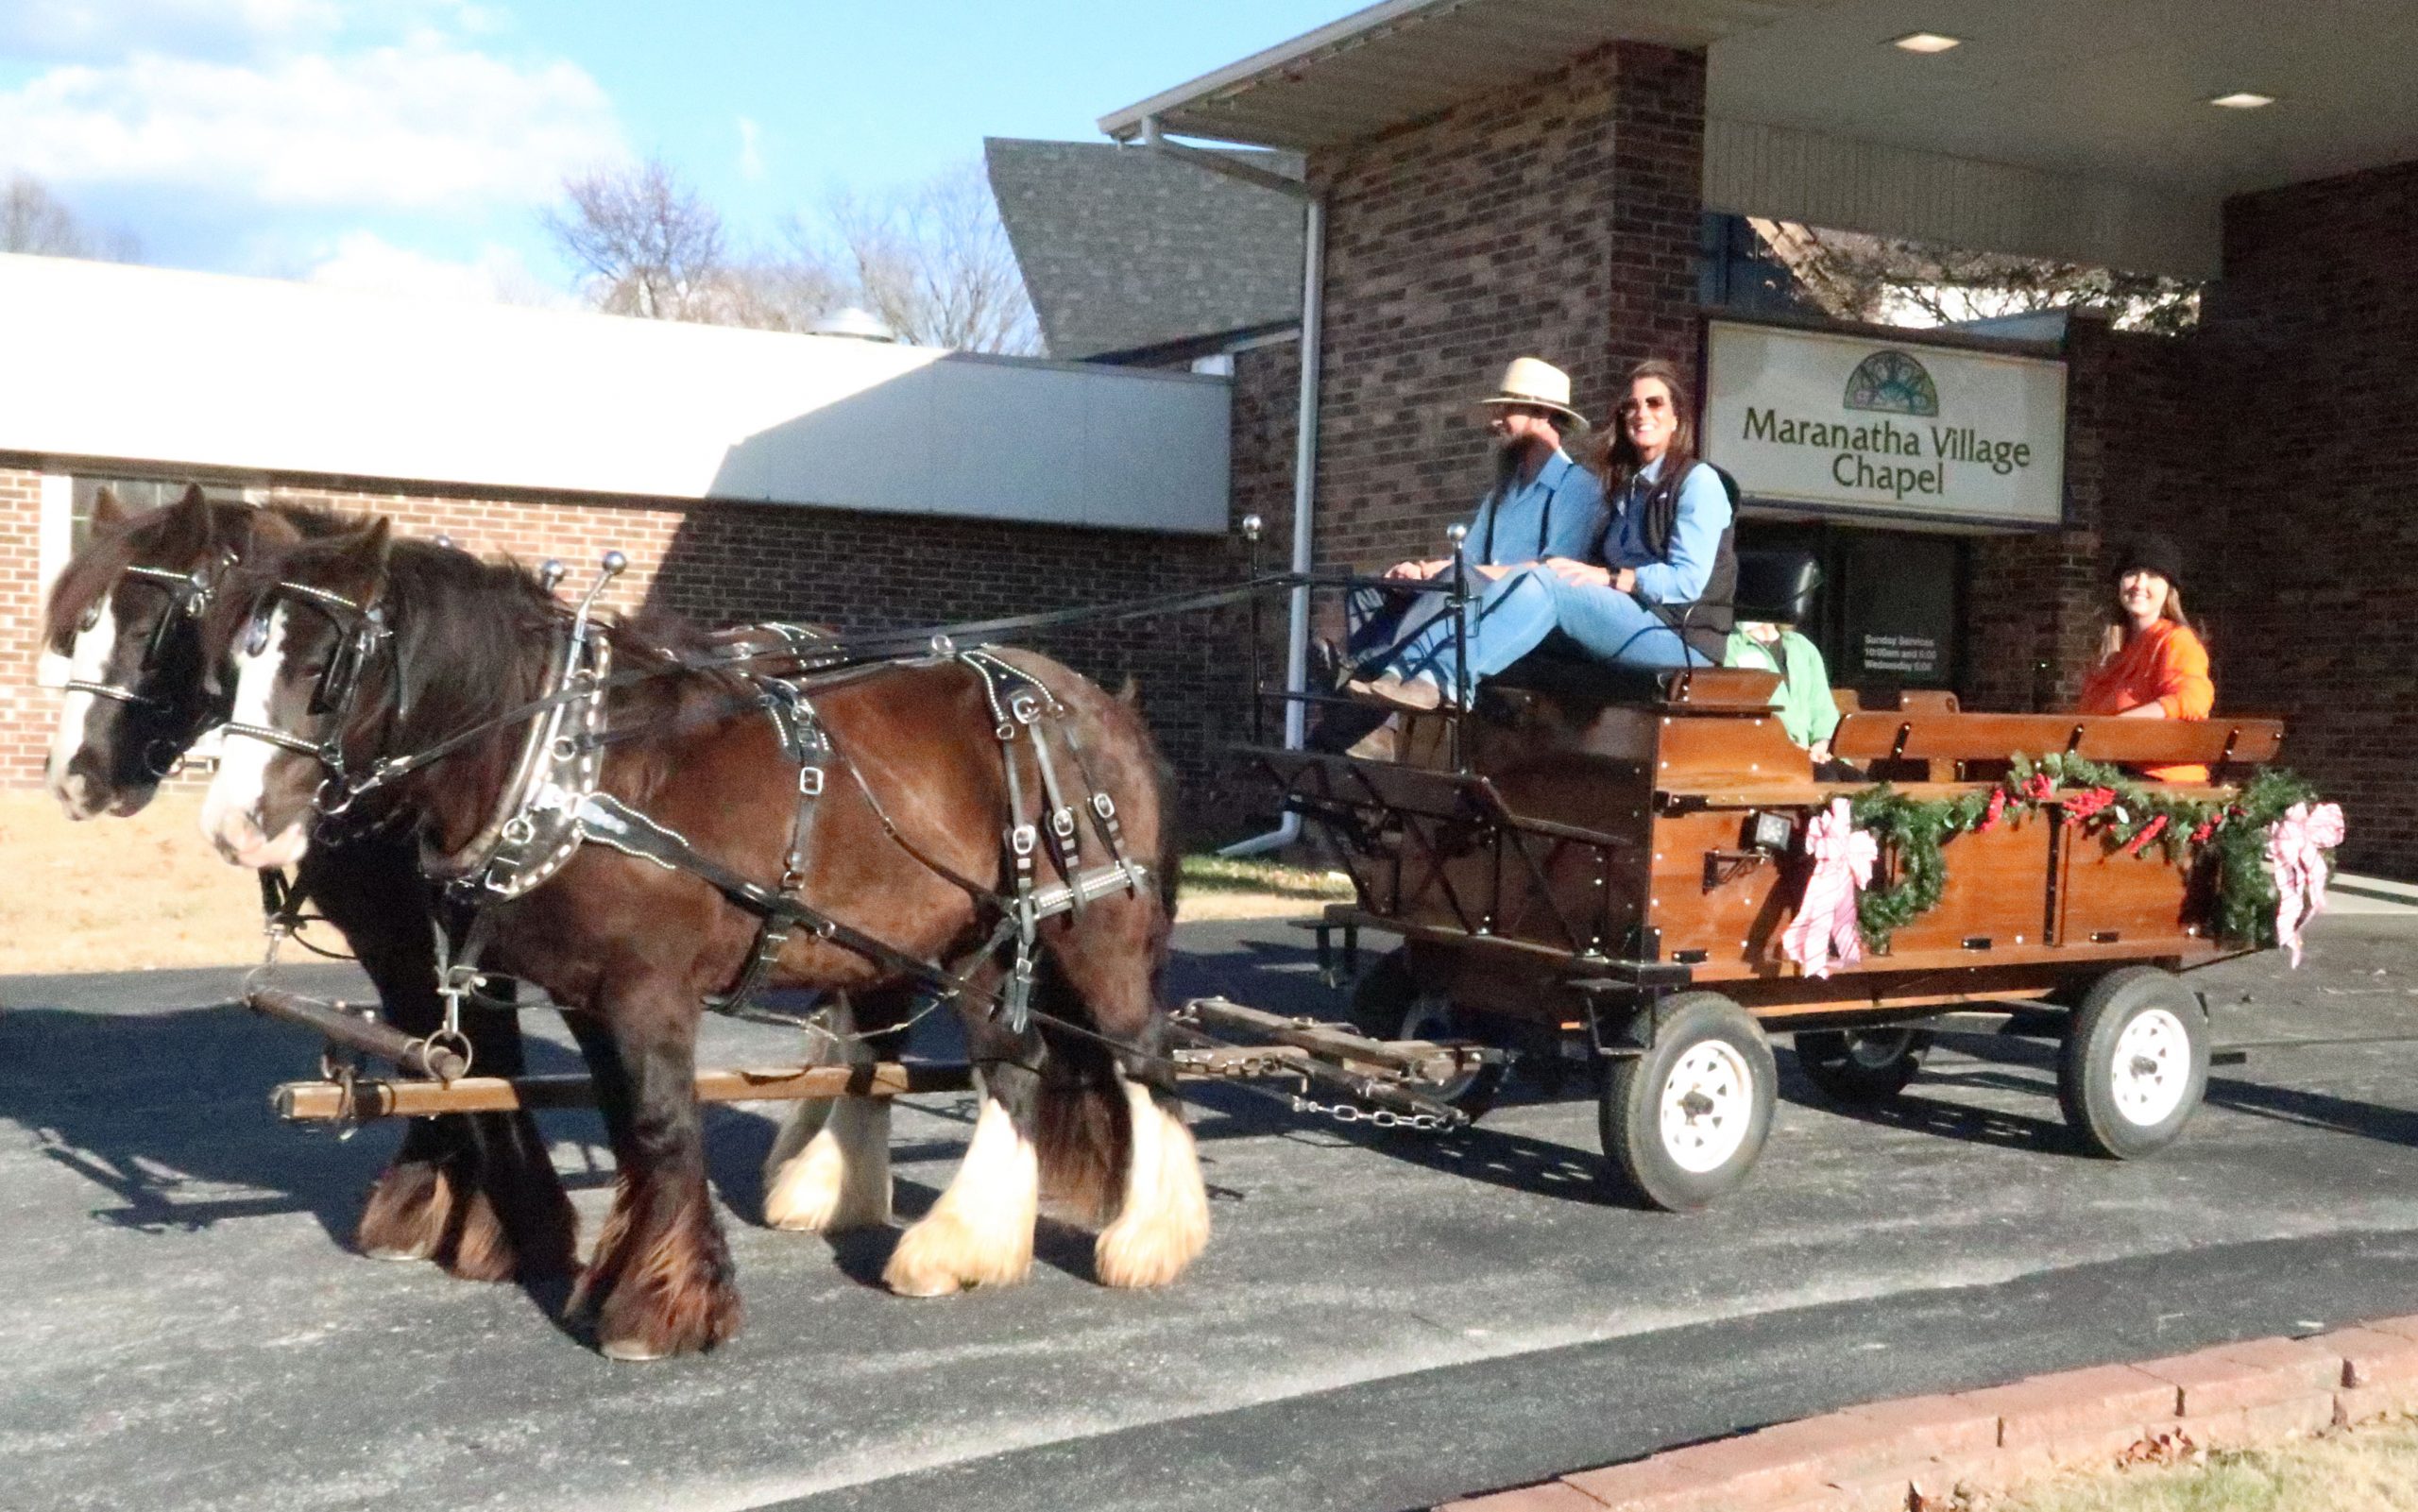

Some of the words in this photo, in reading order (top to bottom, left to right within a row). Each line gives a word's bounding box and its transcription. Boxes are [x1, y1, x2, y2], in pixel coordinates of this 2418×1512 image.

[1743, 407, 1921, 456] Maranatha
[1931, 426, 2031, 474] Village
[1832, 453, 1944, 500] Chapel
[1865, 634, 1897, 647] Sunday
[1899, 635, 1934, 647] Services
[1901, 649, 1917, 659] and
[1865, 659, 1912, 671] Wednesday
